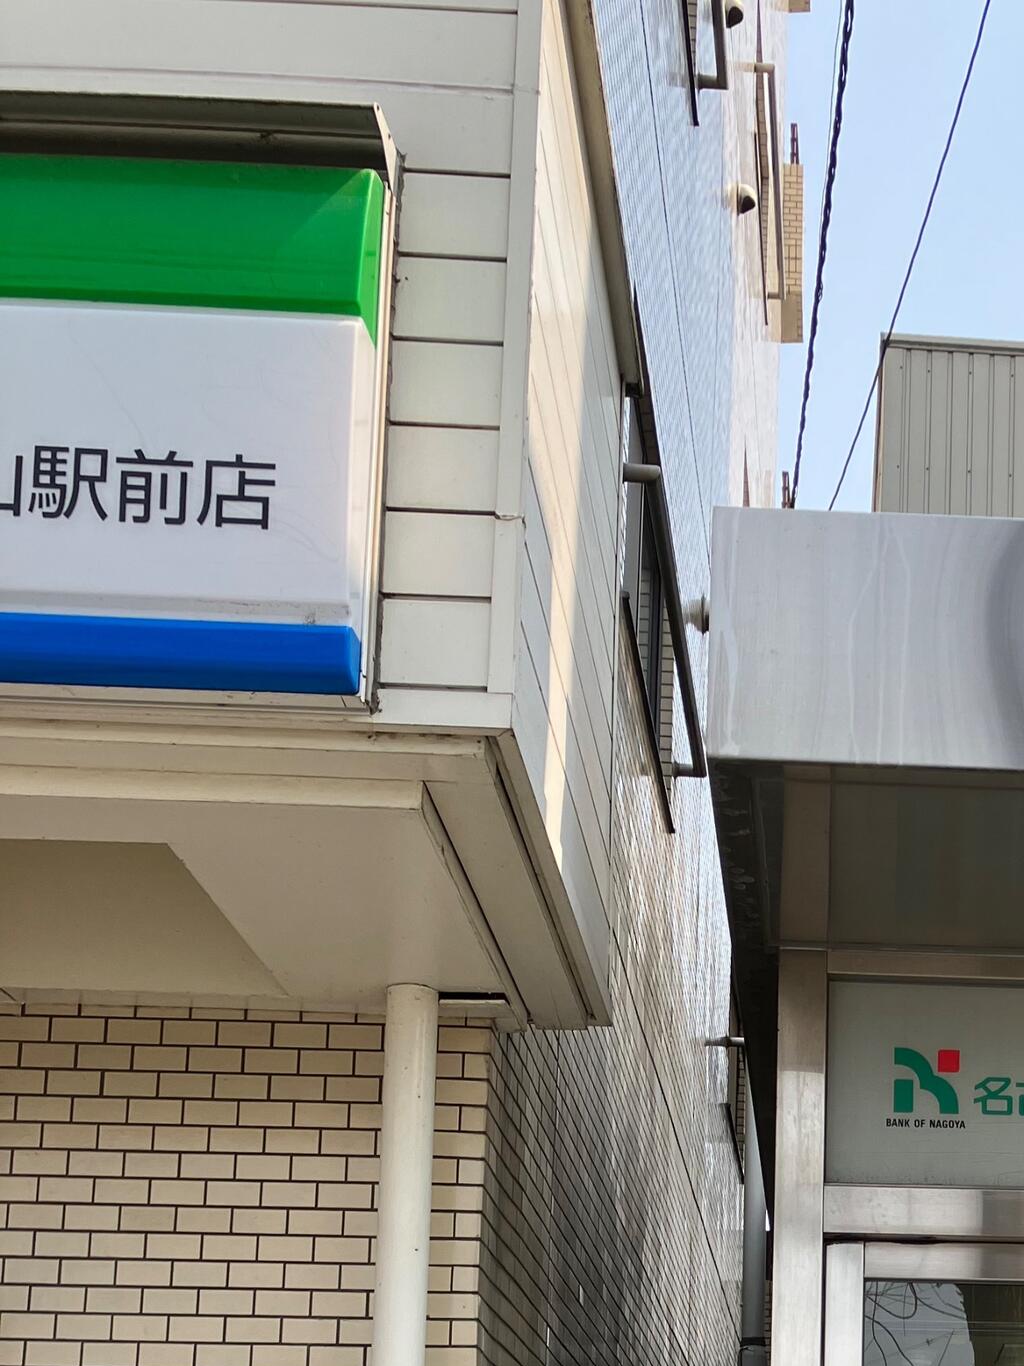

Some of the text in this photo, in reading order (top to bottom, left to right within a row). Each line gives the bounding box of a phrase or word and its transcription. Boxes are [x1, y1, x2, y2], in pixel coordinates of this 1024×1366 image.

[885, 1118, 967, 1130] BANK OF NAGOYA
